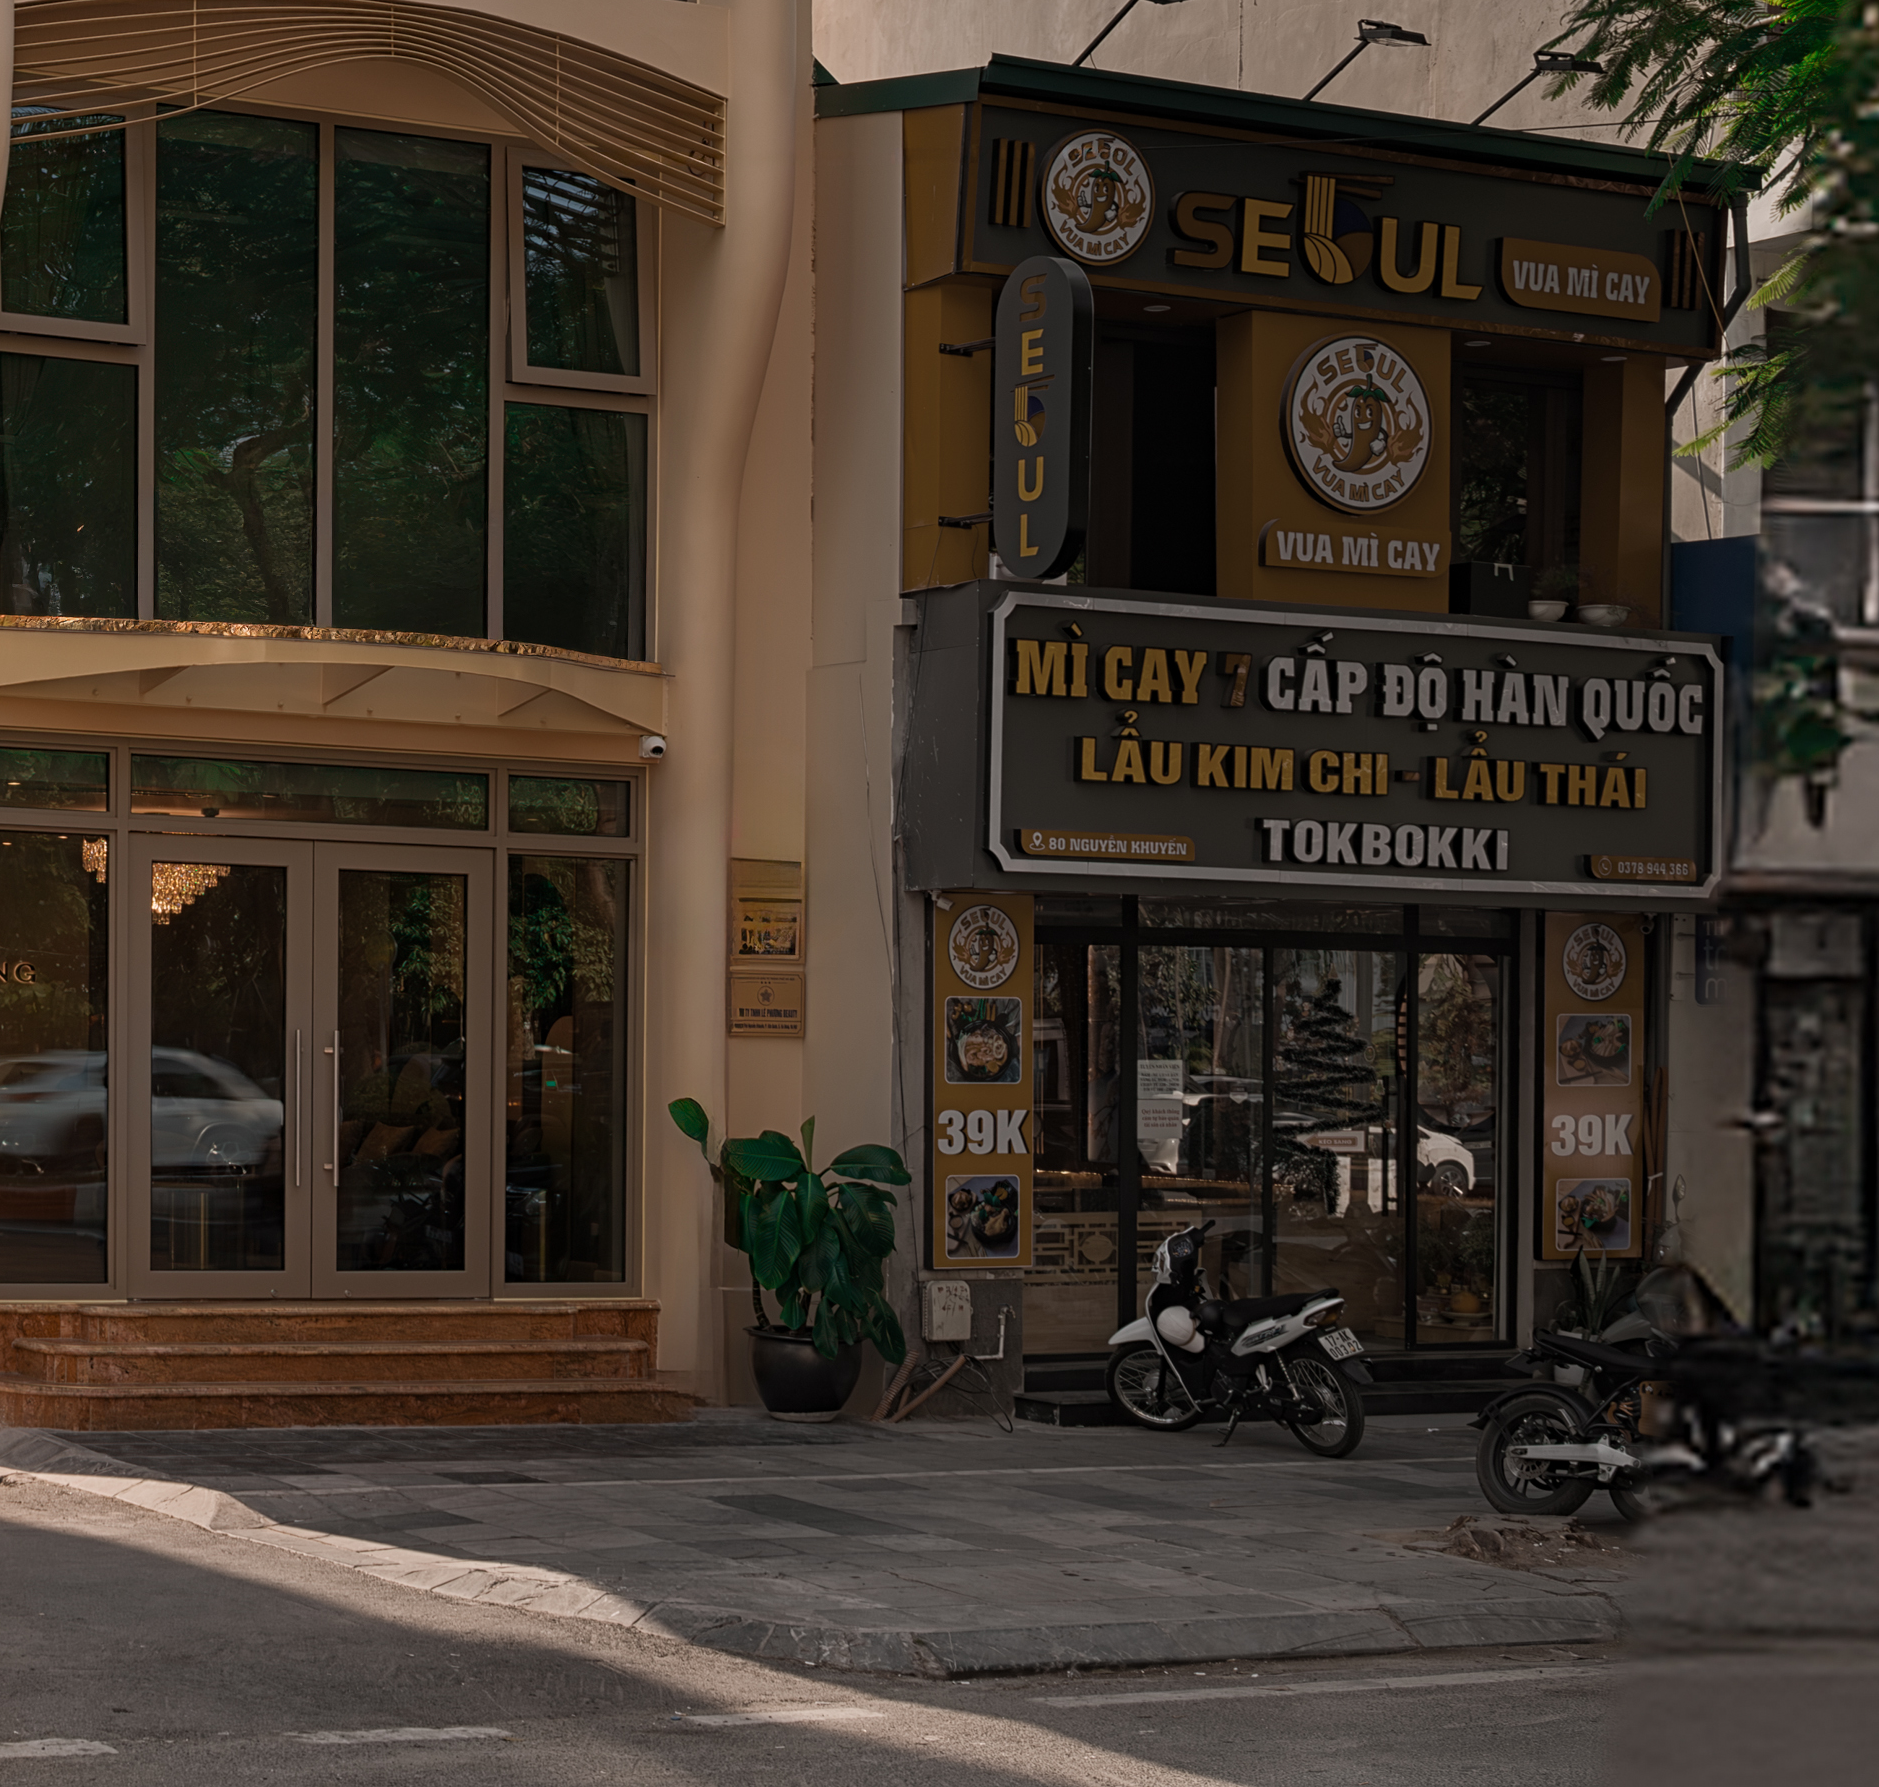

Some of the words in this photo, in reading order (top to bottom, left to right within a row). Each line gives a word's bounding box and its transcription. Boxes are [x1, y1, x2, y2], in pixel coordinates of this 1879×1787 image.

[1059, 220, 1083, 252] VUA
[1086, 240, 1102, 256] MÌ
[1104, 232, 1129, 254] CAY
[1169, 171, 1484, 301] SEOUL
[1513, 260, 1560, 294] VUA
[1567, 264, 1598, 299] MÌ
[1605, 273, 1650, 304] CAY
[1317, 343, 1408, 394] SEOUL
[1312, 455, 1350, 499] VUA
[1349, 480, 1370, 502] MÌ
[1372, 469, 1406, 501] CAY
[1277, 530, 1333, 564] VUA
[1341, 533, 1380, 567] MÌ
[1387, 540, 1440, 572] CAY
[1010, 620, 1089, 698] MÌ
[1100, 645, 1208, 705] CAY
[1217, 651, 1252, 707] 7
[1263, 631, 1369, 714] CẤP
[1377, 652, 1448, 731] ĐỘ
[1456, 653, 1569, 727] HÀN
[1578, 656, 1704, 741] QUỐC
[1076, 710, 1184, 785] LẨU
[1191, 742, 1295, 791] KIM
[1302, 749, 1389, 796] CHI
[1429, 729, 1525, 803] LẨU
[1532, 751, 1647, 809] THÁI
[1049, 837, 1066, 851] 80
[1070, 835, 1127, 853] NGUYỄN
[1131, 838, 1187, 855] KHUYẾN
[1258, 817, 1509, 871] TOKBOKKI
[1618, 861, 1643, 874] 0378
[1647, 862, 1666, 875] 944
[1669, 863, 1689, 876] 366
[959, 965, 977, 985] VUA
[990, 968, 1007, 985] CAY
[1599, 981, 1617, 996] CAY
[937, 1109, 1029, 1155] 39K
[1551, 1113, 1634, 1157] 39K
